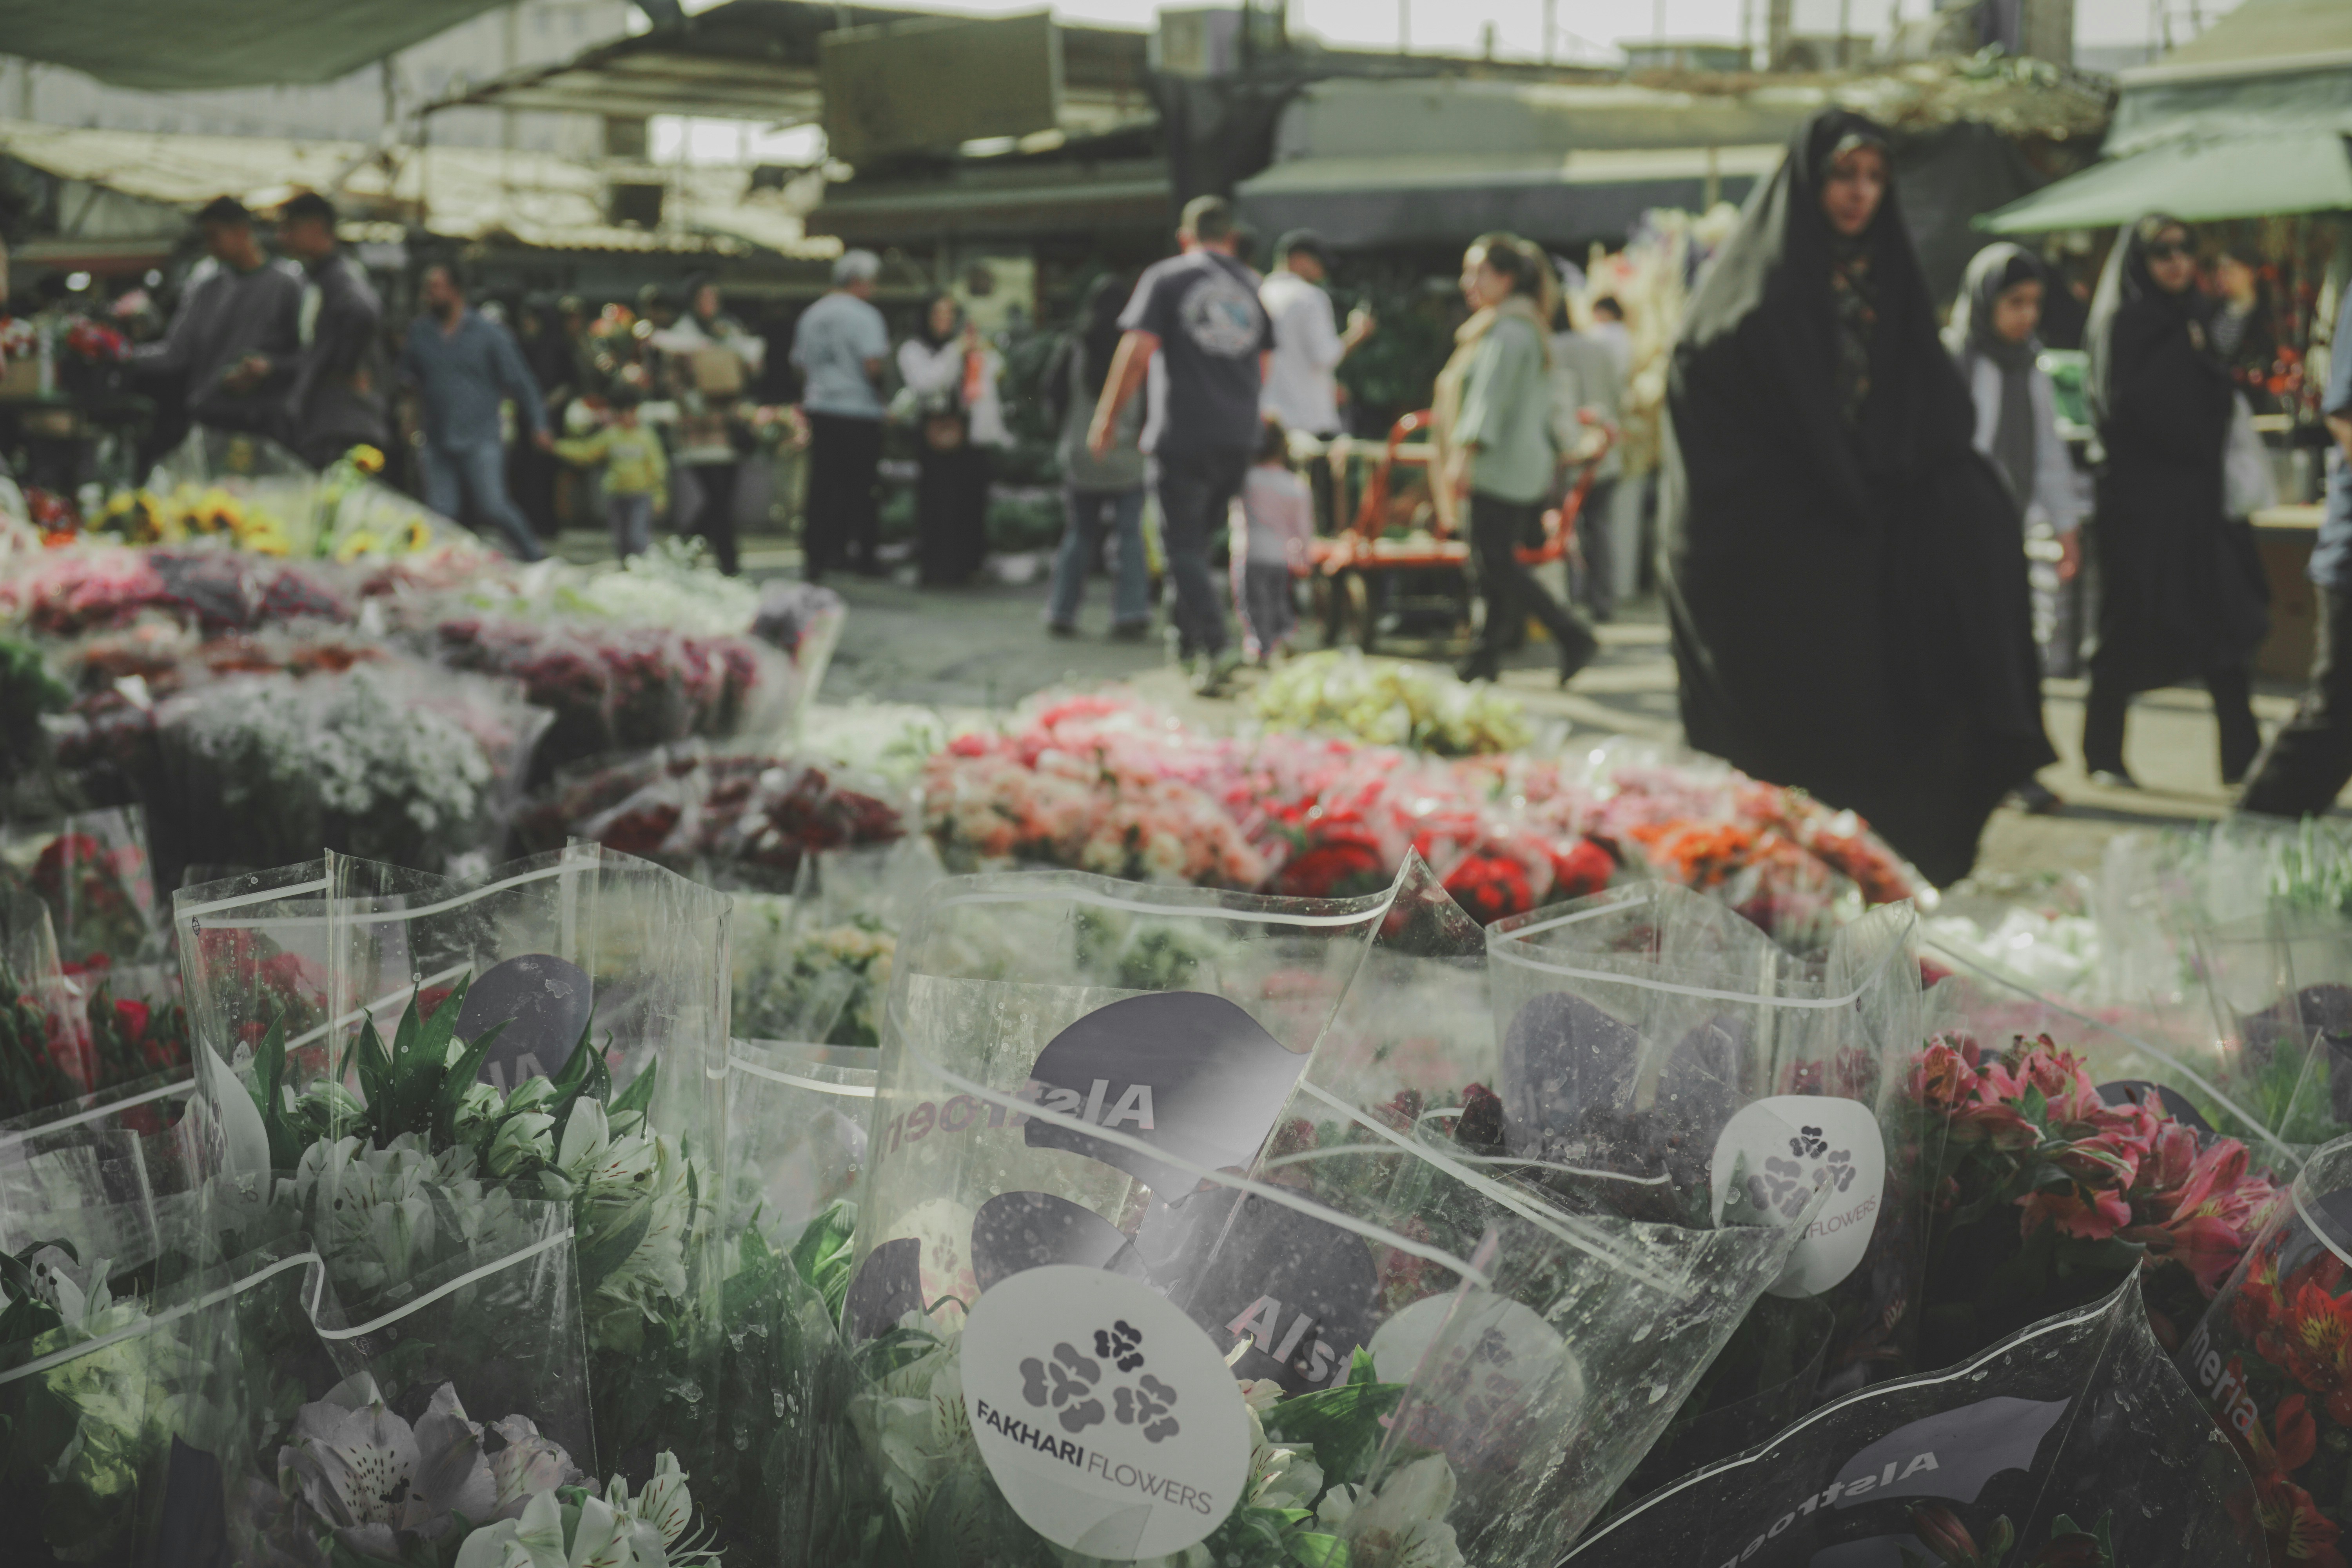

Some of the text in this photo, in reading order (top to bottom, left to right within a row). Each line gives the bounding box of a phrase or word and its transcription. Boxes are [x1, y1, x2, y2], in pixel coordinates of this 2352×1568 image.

[1810, 1195, 1877, 1238] FLOWERS
[977, 1399, 1213, 1515] FAKHARI FLOWERS
